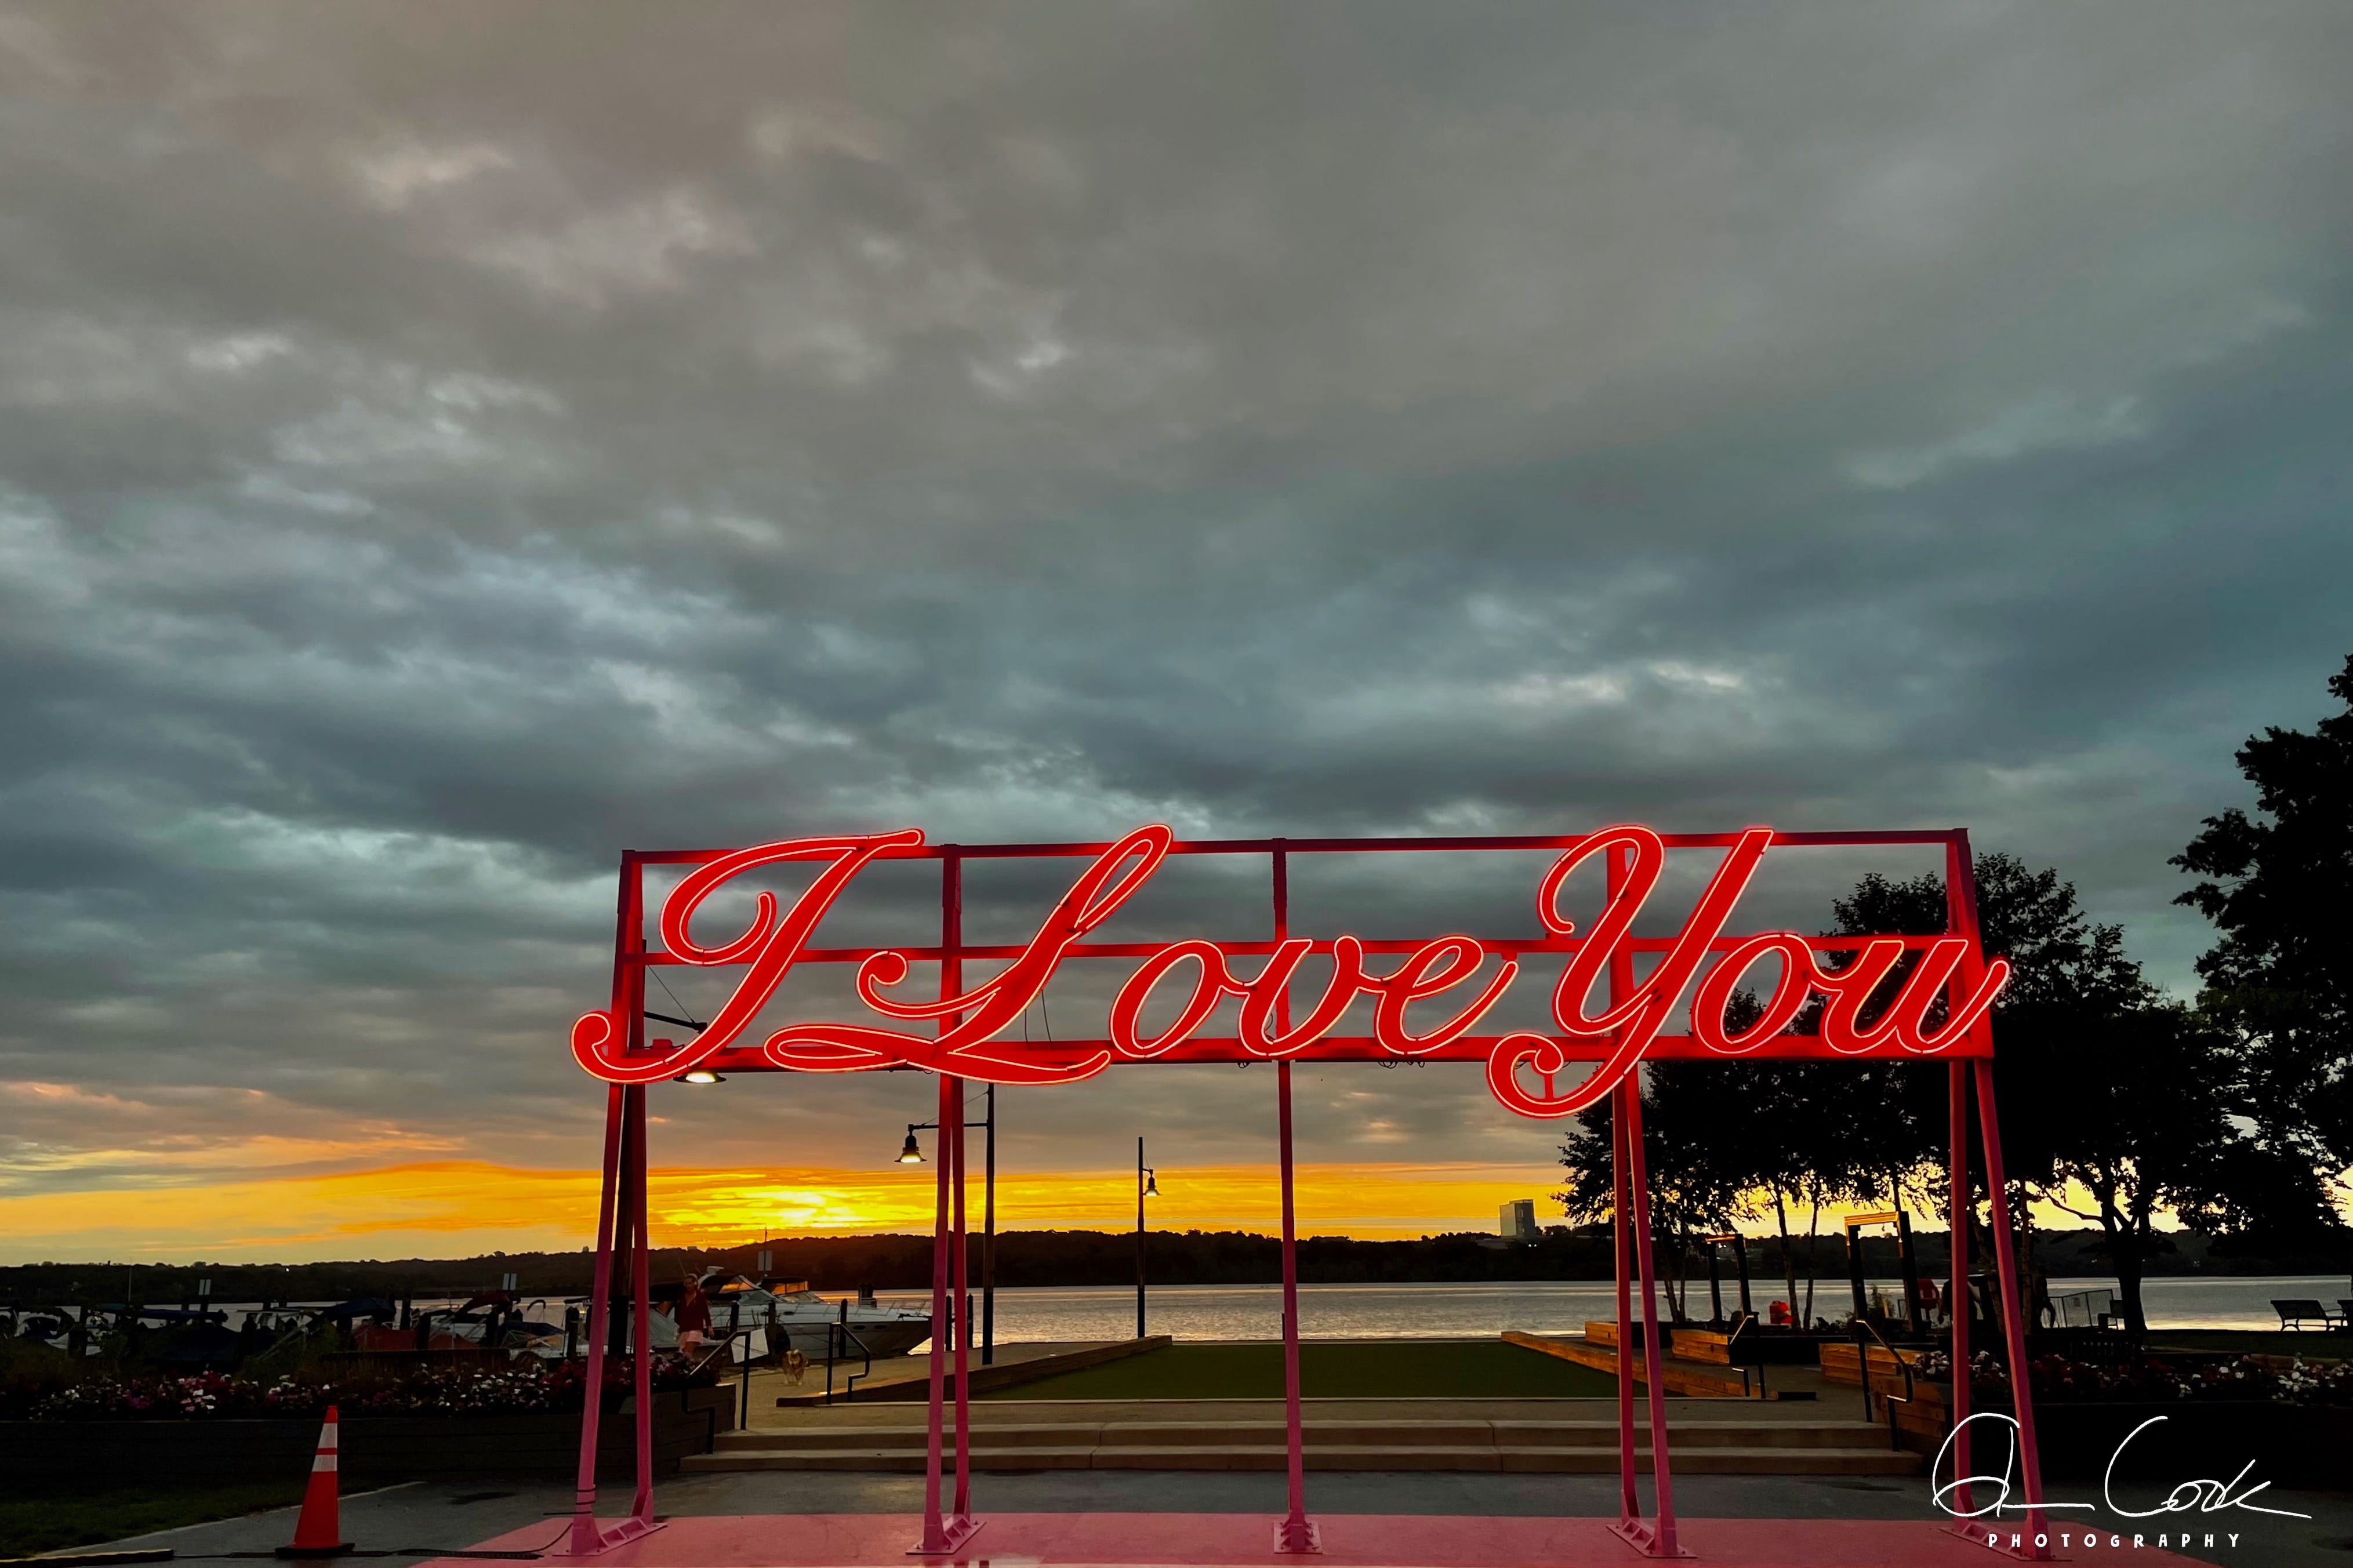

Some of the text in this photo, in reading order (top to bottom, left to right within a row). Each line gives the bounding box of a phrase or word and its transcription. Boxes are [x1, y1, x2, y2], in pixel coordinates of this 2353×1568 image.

[571, 823, 2010, 1119] I Love You
